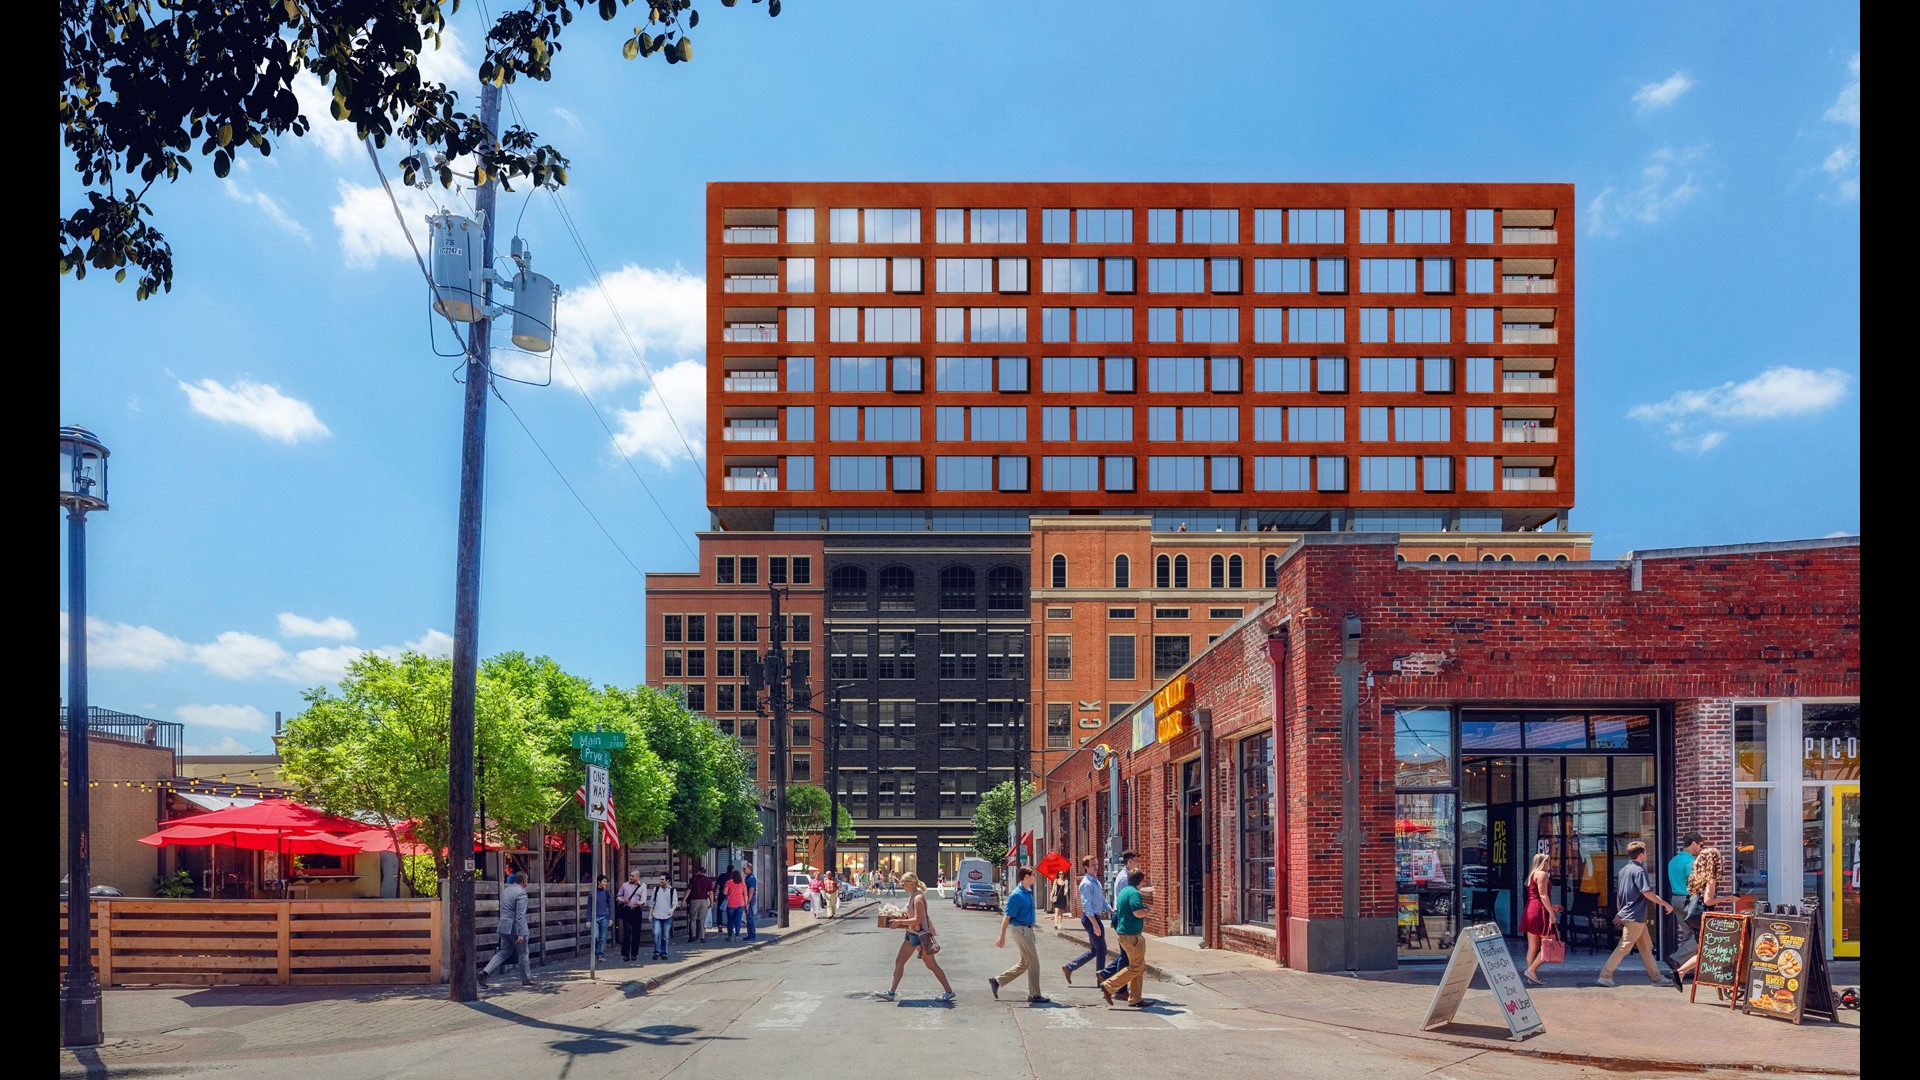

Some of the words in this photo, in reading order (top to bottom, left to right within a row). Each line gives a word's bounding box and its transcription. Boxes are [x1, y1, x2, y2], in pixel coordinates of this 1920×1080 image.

[1078, 699, 1102, 745] CK
[580, 735, 601, 746] Main
[1804, 736, 1857, 759] PICO
[592, 770, 606, 784] ONE
[593, 784, 606, 798] WAY
